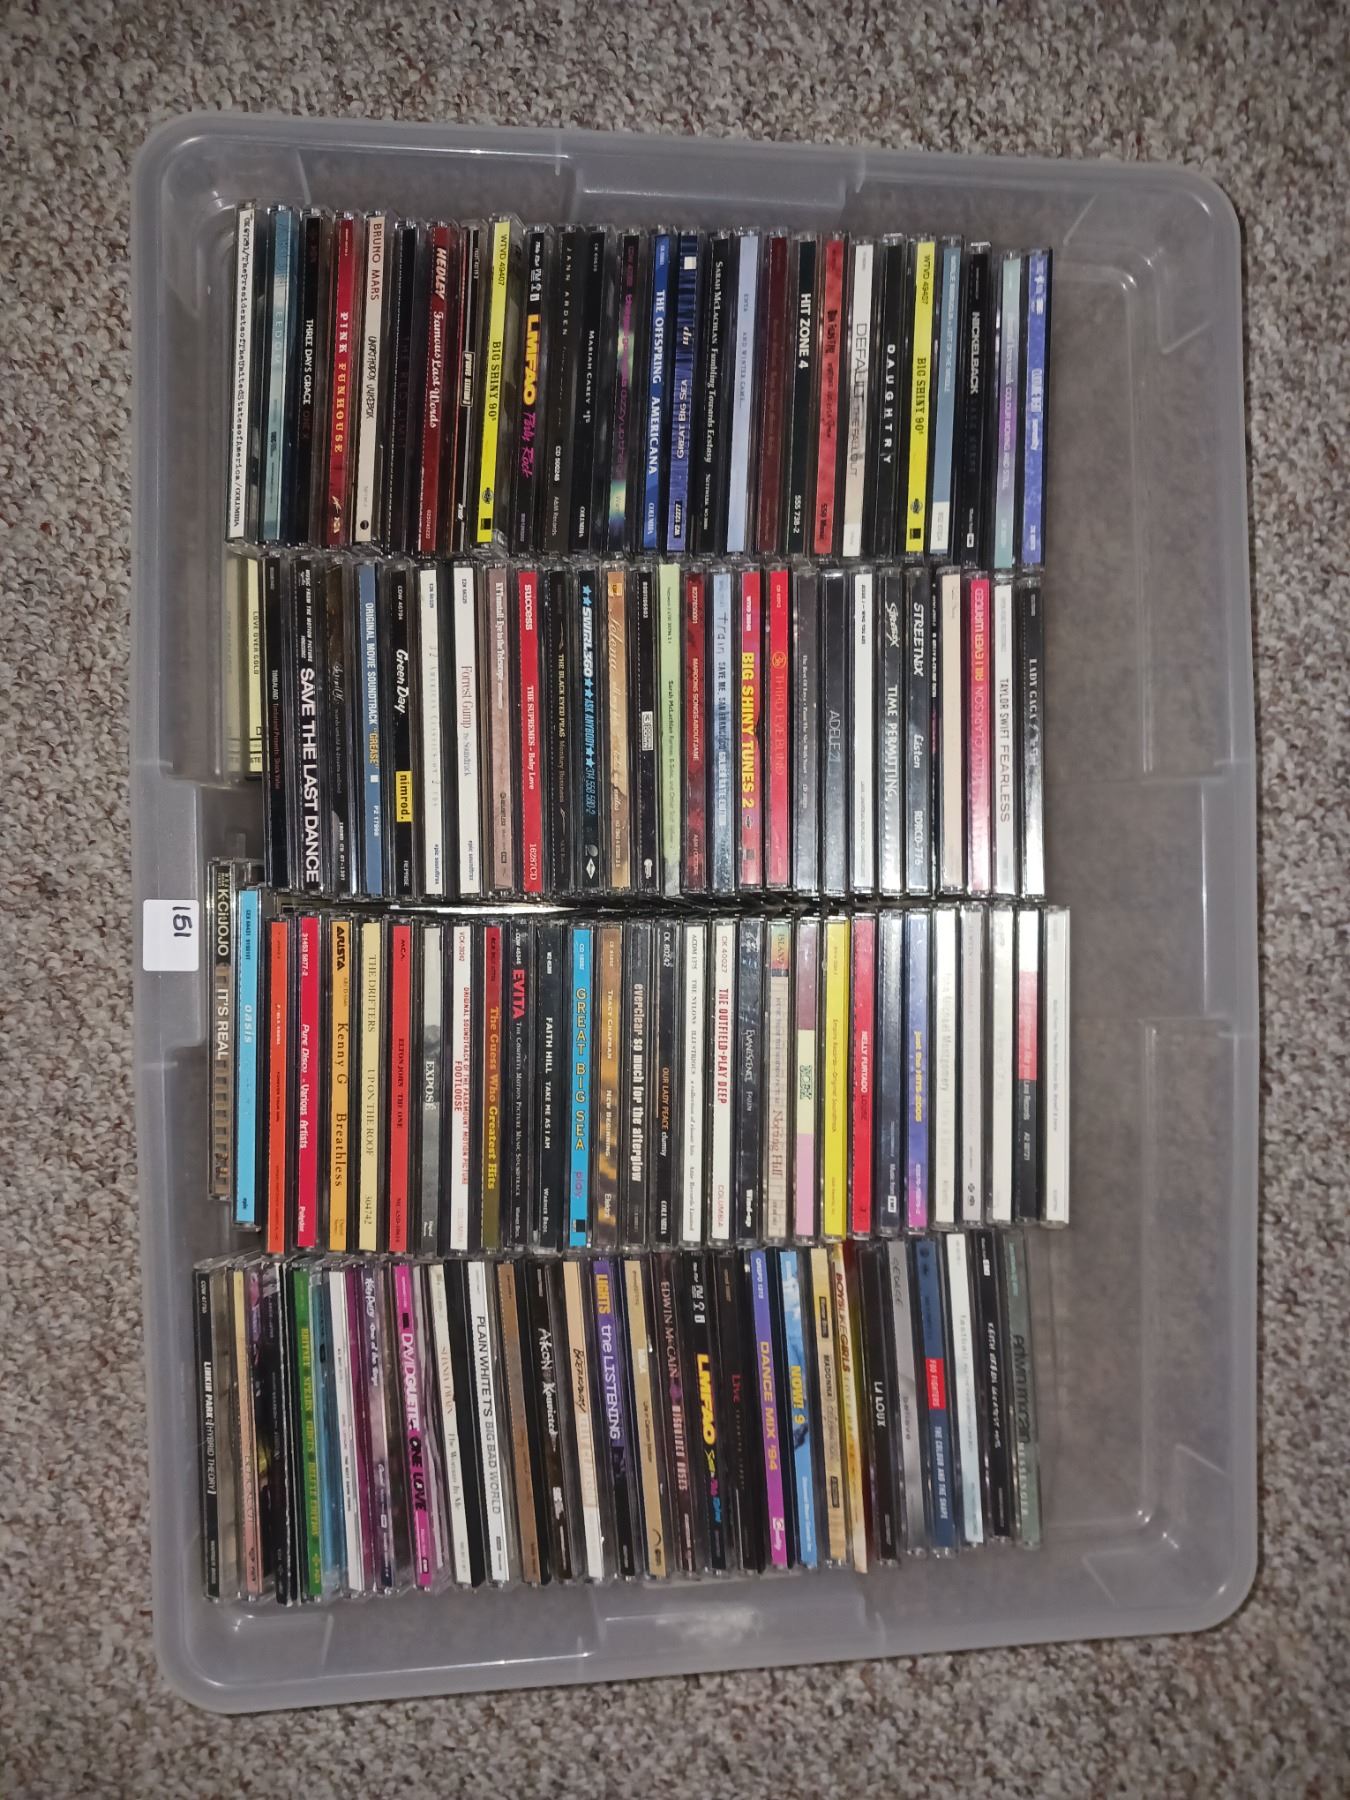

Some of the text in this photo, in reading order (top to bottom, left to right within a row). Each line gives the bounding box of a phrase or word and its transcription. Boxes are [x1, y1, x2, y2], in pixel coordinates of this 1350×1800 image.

[370, 223, 382, 301] BRUNO MARS
[714, 261, 724, 290] SARAH
[562, 291, 570, 336] ARDEN
[801, 293, 811, 316] HIT
[303, 319, 313, 405] THREE DAYS GRACE
[429, 248, 446, 428] HEDLEY Famous Last Words
[523, 314, 539, 406] LMFAO
[586, 330, 595, 370] MARIAH
[799, 318, 810, 357] ZONE
[853, 323, 867, 401] DEFAULT
[970, 311, 981, 394] NICKELBACK
[489, 341, 501, 400] BIG SHINY
[648, 289, 665, 474] THE OFFSPRING AMERICANA
[798, 360, 808, 369] 4
[916, 358, 927, 378] BIG
[334, 363, 346, 453] FUNHOUSE
[678, 403, 687, 421] BIG
[883, 344, 896, 464] DAUGHTRY
[554, 446, 562, 456] CD
[677, 425, 686, 459] GREAT
[524, 584, 533, 630] success
[365, 602, 378, 725] ORIGINAL MOVIE SOUNDTRACK
[717, 662, 726, 678] SAVE
[1029, 659, 1038, 688] LADY
[300, 668, 315, 716] SAVE
[459, 665, 475, 729] Forrest Gump
[302, 719, 316, 760] THE
[395, 649, 410, 820] Green Day nimrod.
[527, 703, 535, 746] SUPREMES
[584, 713, 596, 748] ANYBODY
[742, 652, 755, 808] BIG SHINY TUNES 2
[887, 684, 898, 798] TIME PERMITTING
[528, 752, 536, 772] Baby
[999, 678, 1010, 823] TAYLOR SWIFT FEARLESS
[303, 764, 318, 811] LAST
[304, 815, 320, 882] DANCE
[664, 931, 670, 942] CK
[722, 936, 728, 947] CK
[512, 969, 525, 1019] EVITA
[718, 989, 728, 1005] THE
[217, 988, 230, 1060] IT'S REAL
[244, 1004, 254, 1044] oasis
[334, 926, 348, 1187] ARISTA Kenny G Breathless
[365, 955, 377, 1156] THE DRIFTERS THE ROOF
[575, 988, 587, 1151] GREAT BIG SEA
[454, 1060, 463, 1112] FOOTLOOSE
[486, 1007, 499, 1189] The Guess Who Greatest Hits
[631, 983, 645, 1182] everclear so much for the afterglow
[718, 1081, 728, 1104] DEEP
[300, 1084, 309, 1149] Various Artists
[545, 1103, 551, 1115] ME
[545, 1117, 551, 1128] AS
[544, 1135, 551, 1148] AM
[770, 1110, 785, 1177] Notting Hill
[660, 1281, 673, 1325] EDWIN
[596, 1274, 620, 1440] LIGHTS the LISTENING
[929, 1359, 937, 1373] FOO
[696, 1353, 716, 1445] LMFAO
[760, 1341, 779, 1471] DANCE MIX '94
[790, 1365, 805, 1424] NOW! 9
[930, 1374, 940, 1407] FIGHTERS
[476, 1316, 501, 1515] PLAIN WHITE T'S BIG BAD WORLD
[934, 1426, 943, 1438] THE
[409, 1437, 426, 1511] ONE LOVE
[935, 1440, 945, 1466] COLOUR
[940, 1498, 948, 1519] SHAPE
